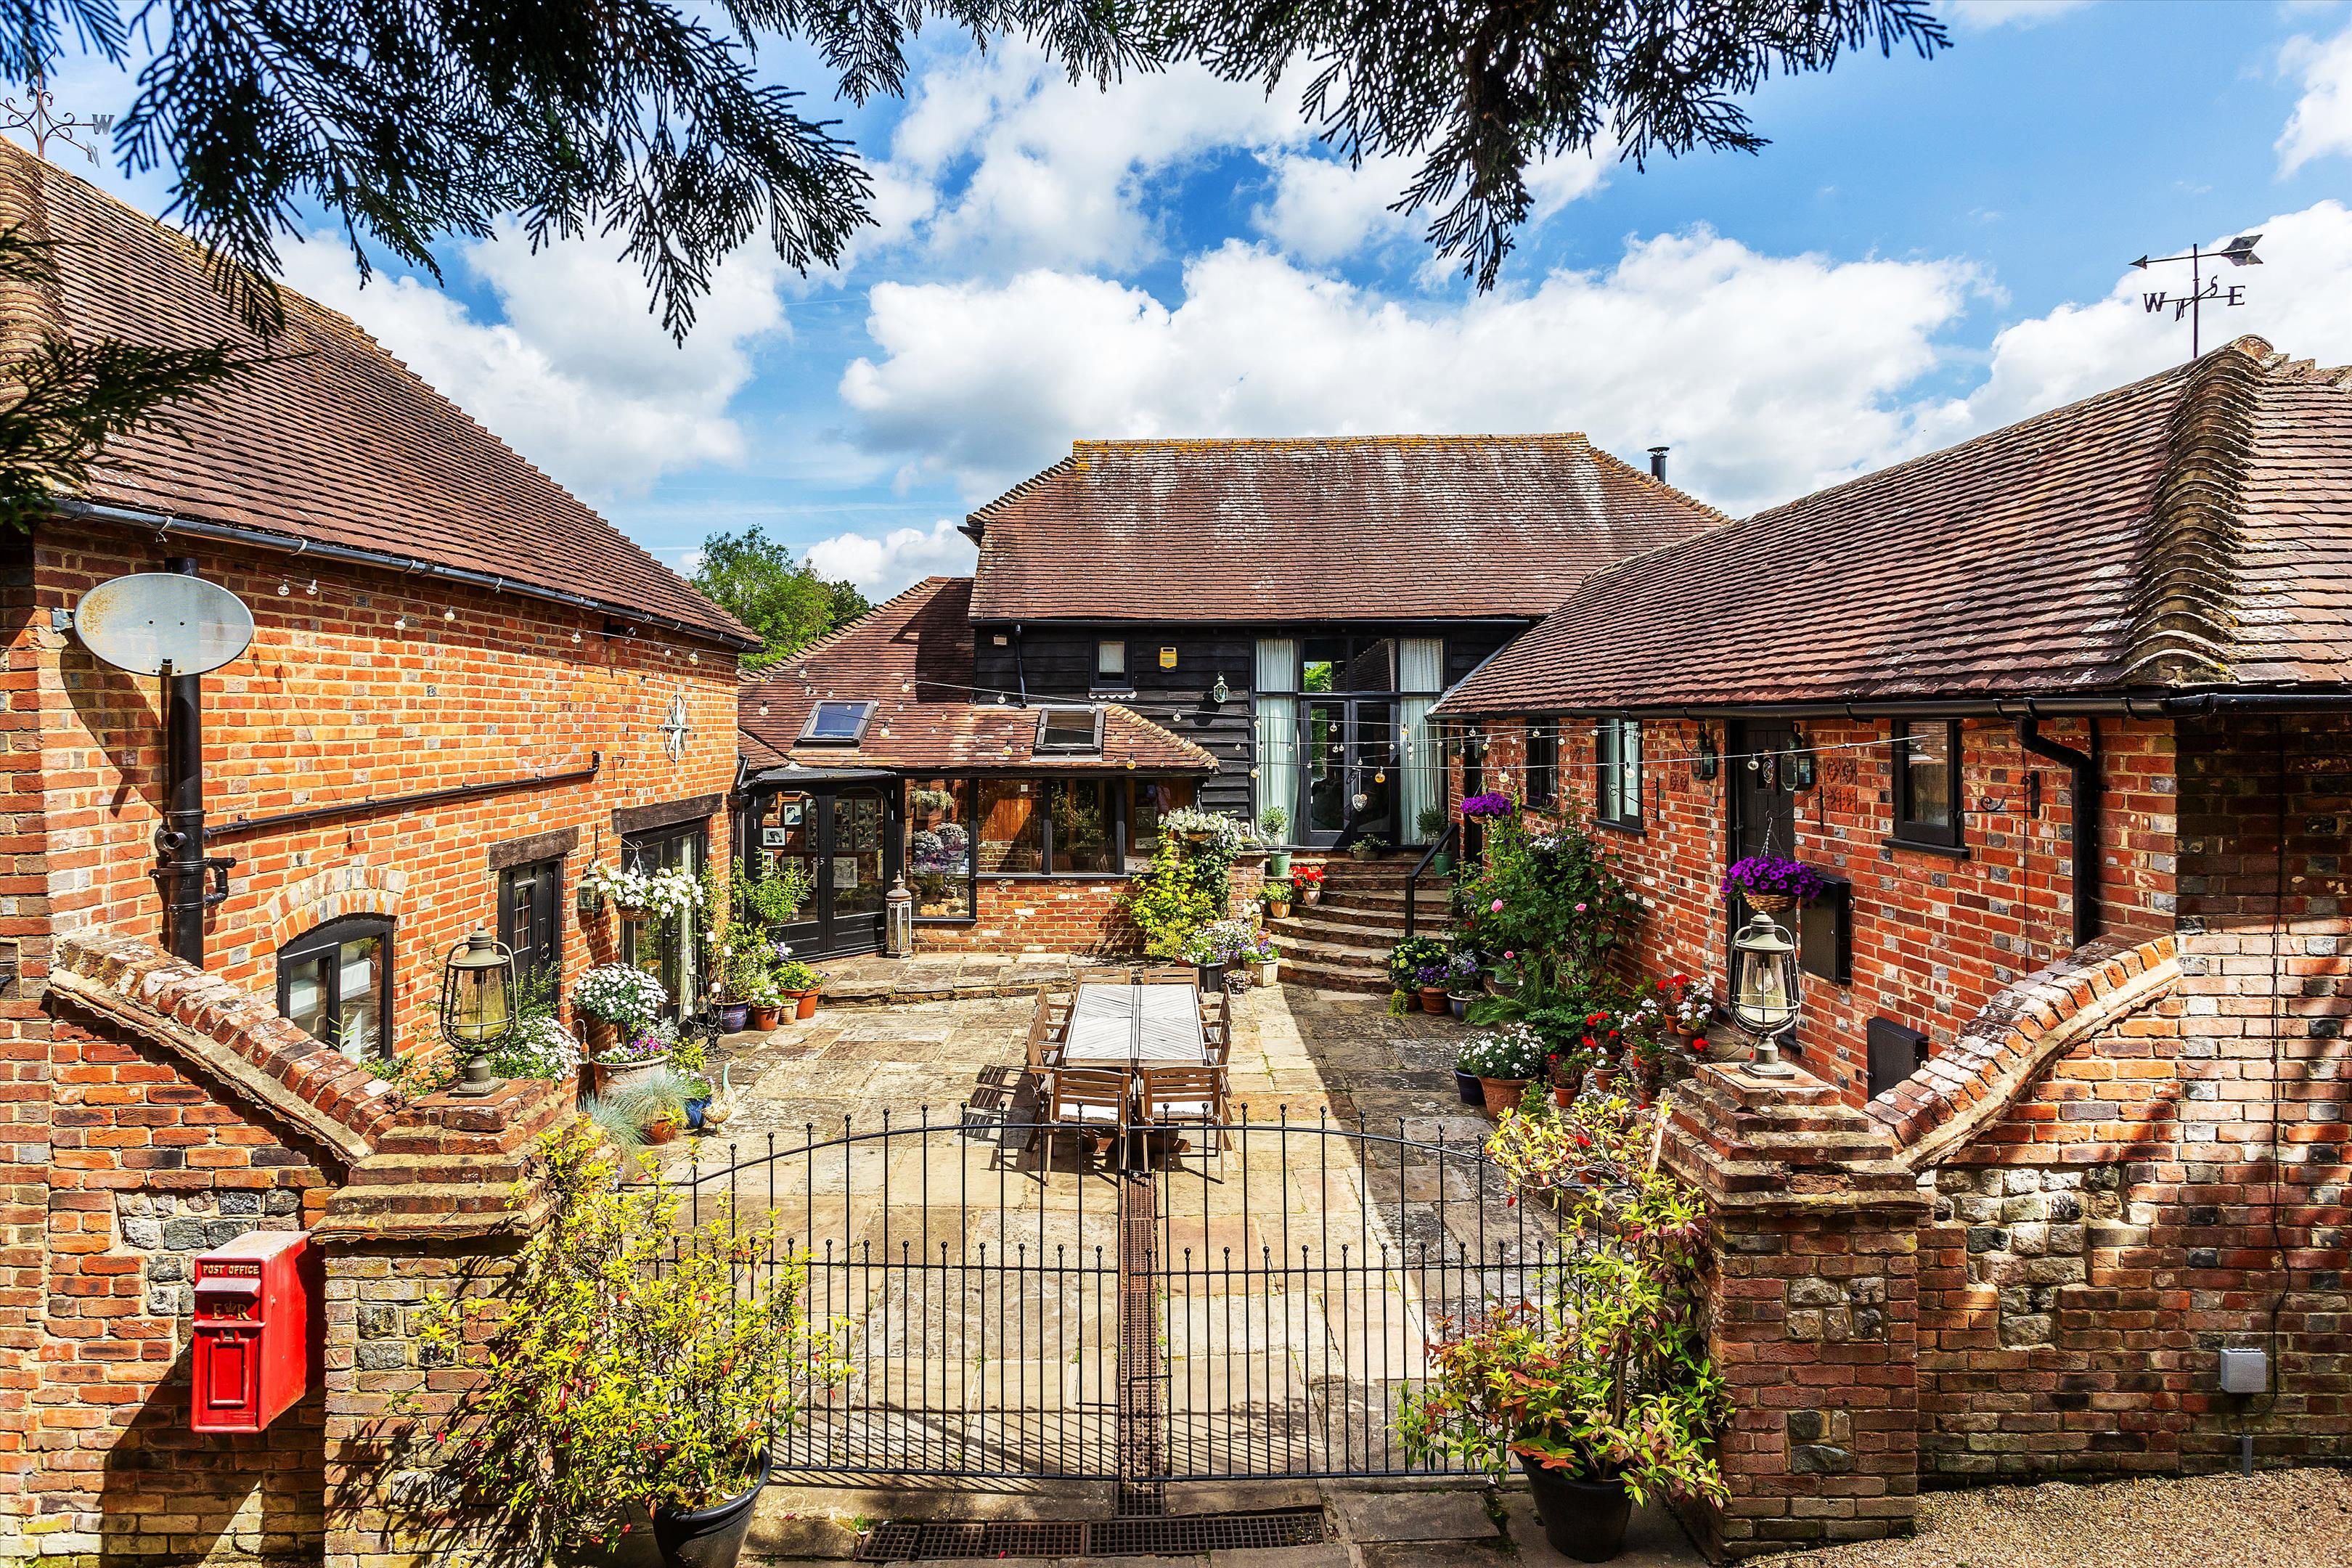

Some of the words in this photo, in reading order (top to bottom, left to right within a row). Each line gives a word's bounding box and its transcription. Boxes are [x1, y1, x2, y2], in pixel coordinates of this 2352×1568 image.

[91, 114, 115, 135] W
[86, 140, 101, 168] N
[2210, 274, 2218, 298] S
[2227, 285, 2246, 306] E
[2143, 292, 2167, 313] W
[203, 1265, 225, 1275] POST
[228, 1265, 260, 1275] OFFICE
